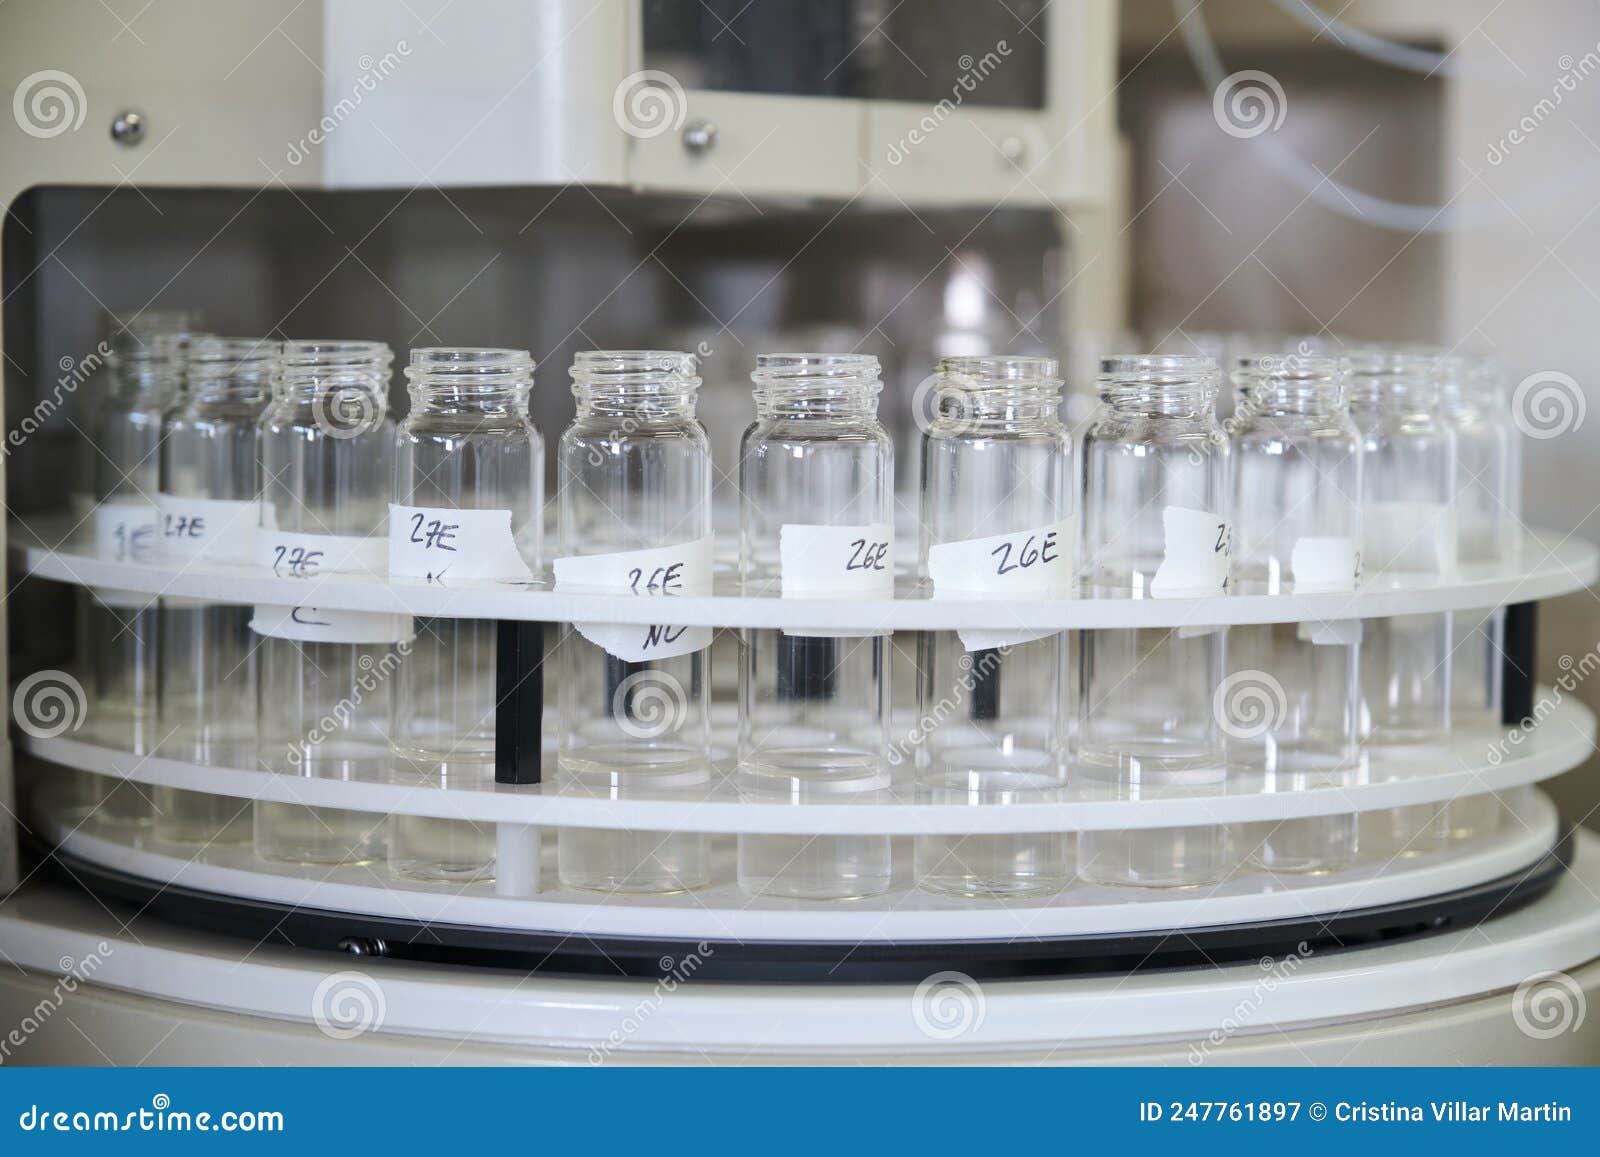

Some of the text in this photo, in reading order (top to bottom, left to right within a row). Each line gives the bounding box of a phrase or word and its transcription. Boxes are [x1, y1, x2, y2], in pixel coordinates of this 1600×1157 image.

[411, 513, 459, 551] 27E
[846, 539, 888, 570] 26E
[991, 532, 1058, 575] 26E
[629, 563, 684, 588] 26E
